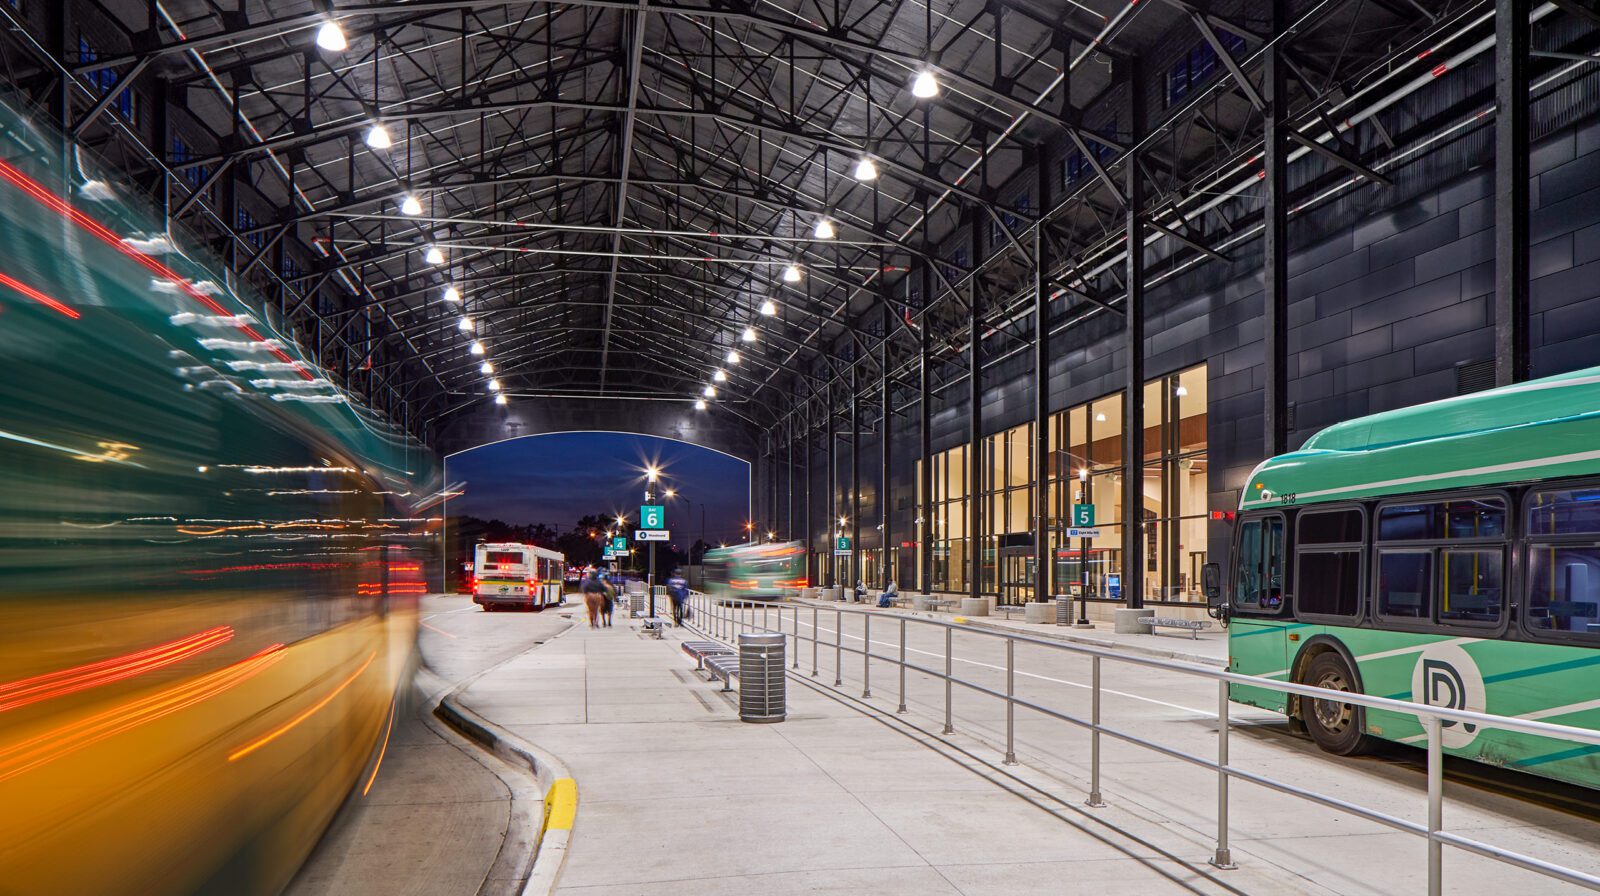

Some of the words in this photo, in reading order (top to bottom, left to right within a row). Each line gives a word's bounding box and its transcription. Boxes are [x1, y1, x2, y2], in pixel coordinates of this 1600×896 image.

[1281, 493, 1296, 504] 1818
[647, 513, 657, 526] 6
[1080, 511, 1089, 524] 5
[616, 541, 623, 549] 4
[841, 541, 846, 549] 3
